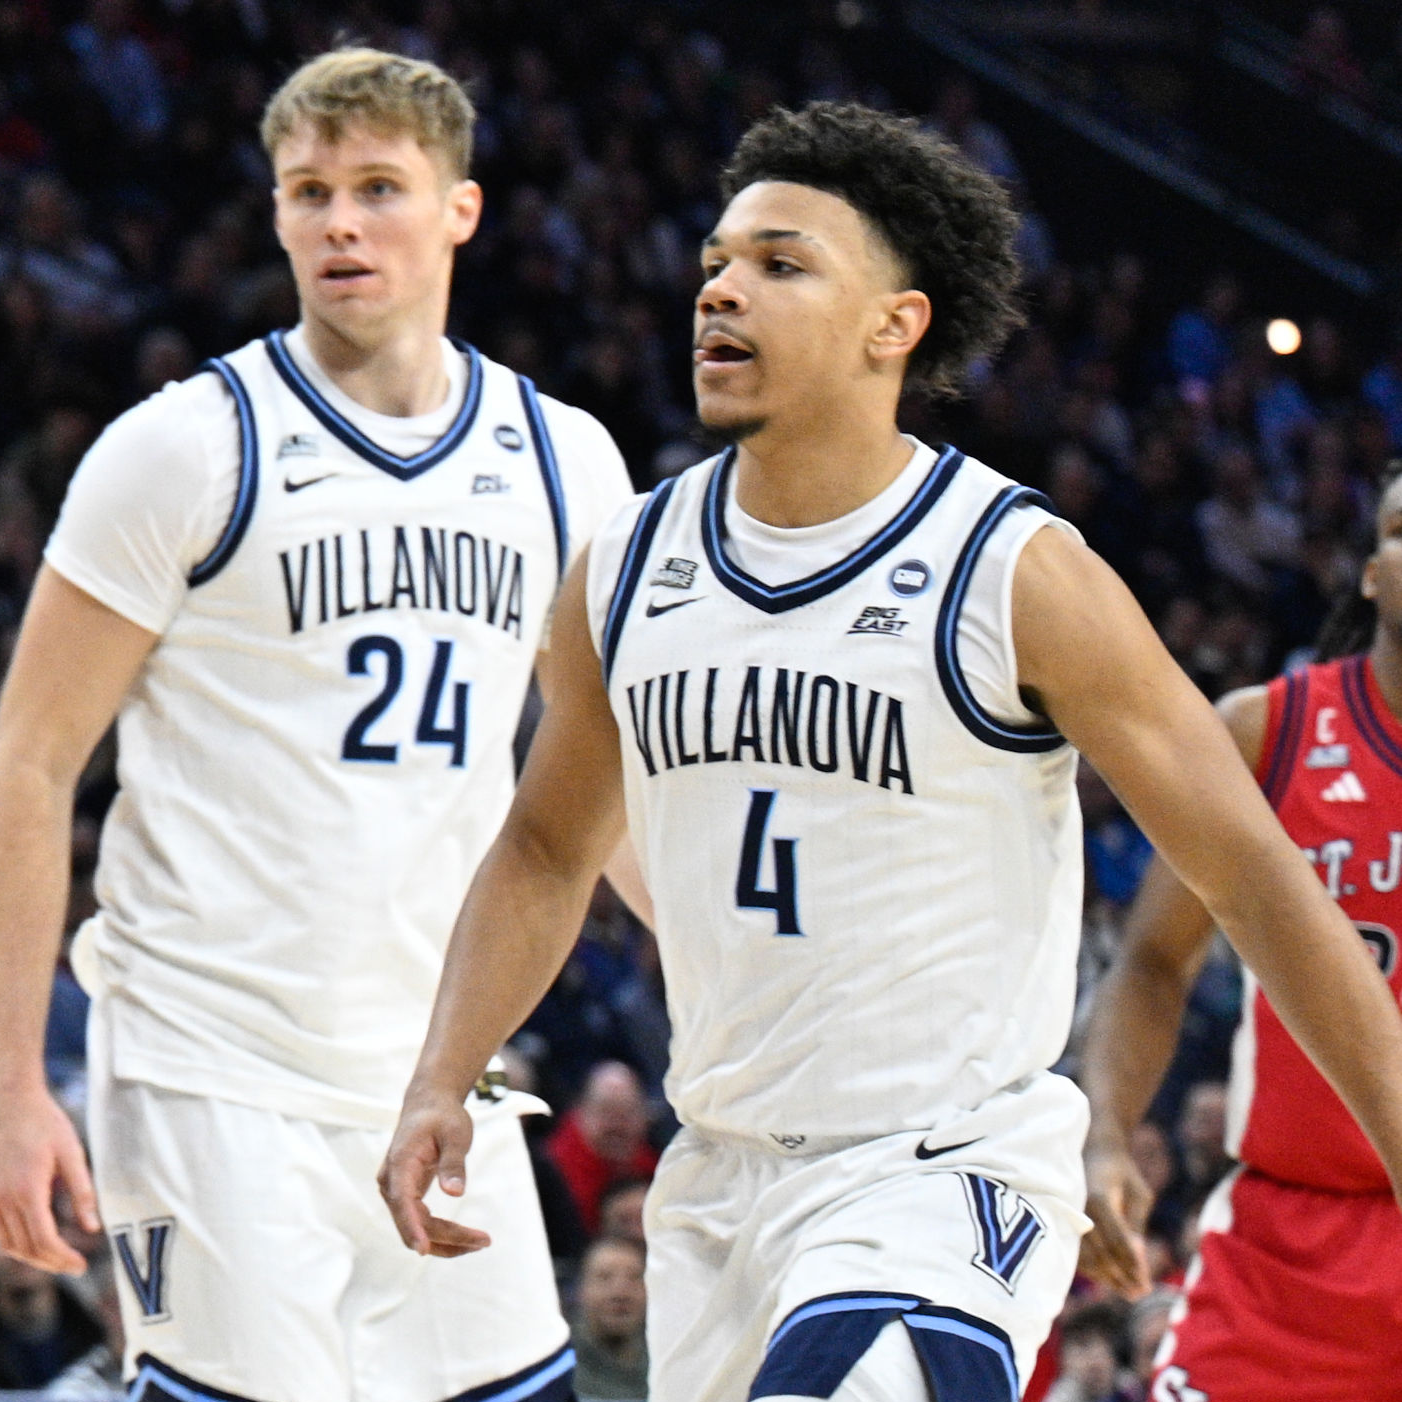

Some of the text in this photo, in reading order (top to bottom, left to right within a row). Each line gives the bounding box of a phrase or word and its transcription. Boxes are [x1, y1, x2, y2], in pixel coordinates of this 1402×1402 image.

[279, 526, 525, 640] VILLANOVA
[851, 617, 910, 632] EAST
[860, 606, 902, 620] BIG
[340, 634, 472, 769] 24
[626, 665, 915, 796] VILLANOVA
[735, 787, 807, 938] 4
[1303, 837, 1358, 900] T.
[111, 1216, 178, 1326] V
[957, 1171, 1048, 1297] V
